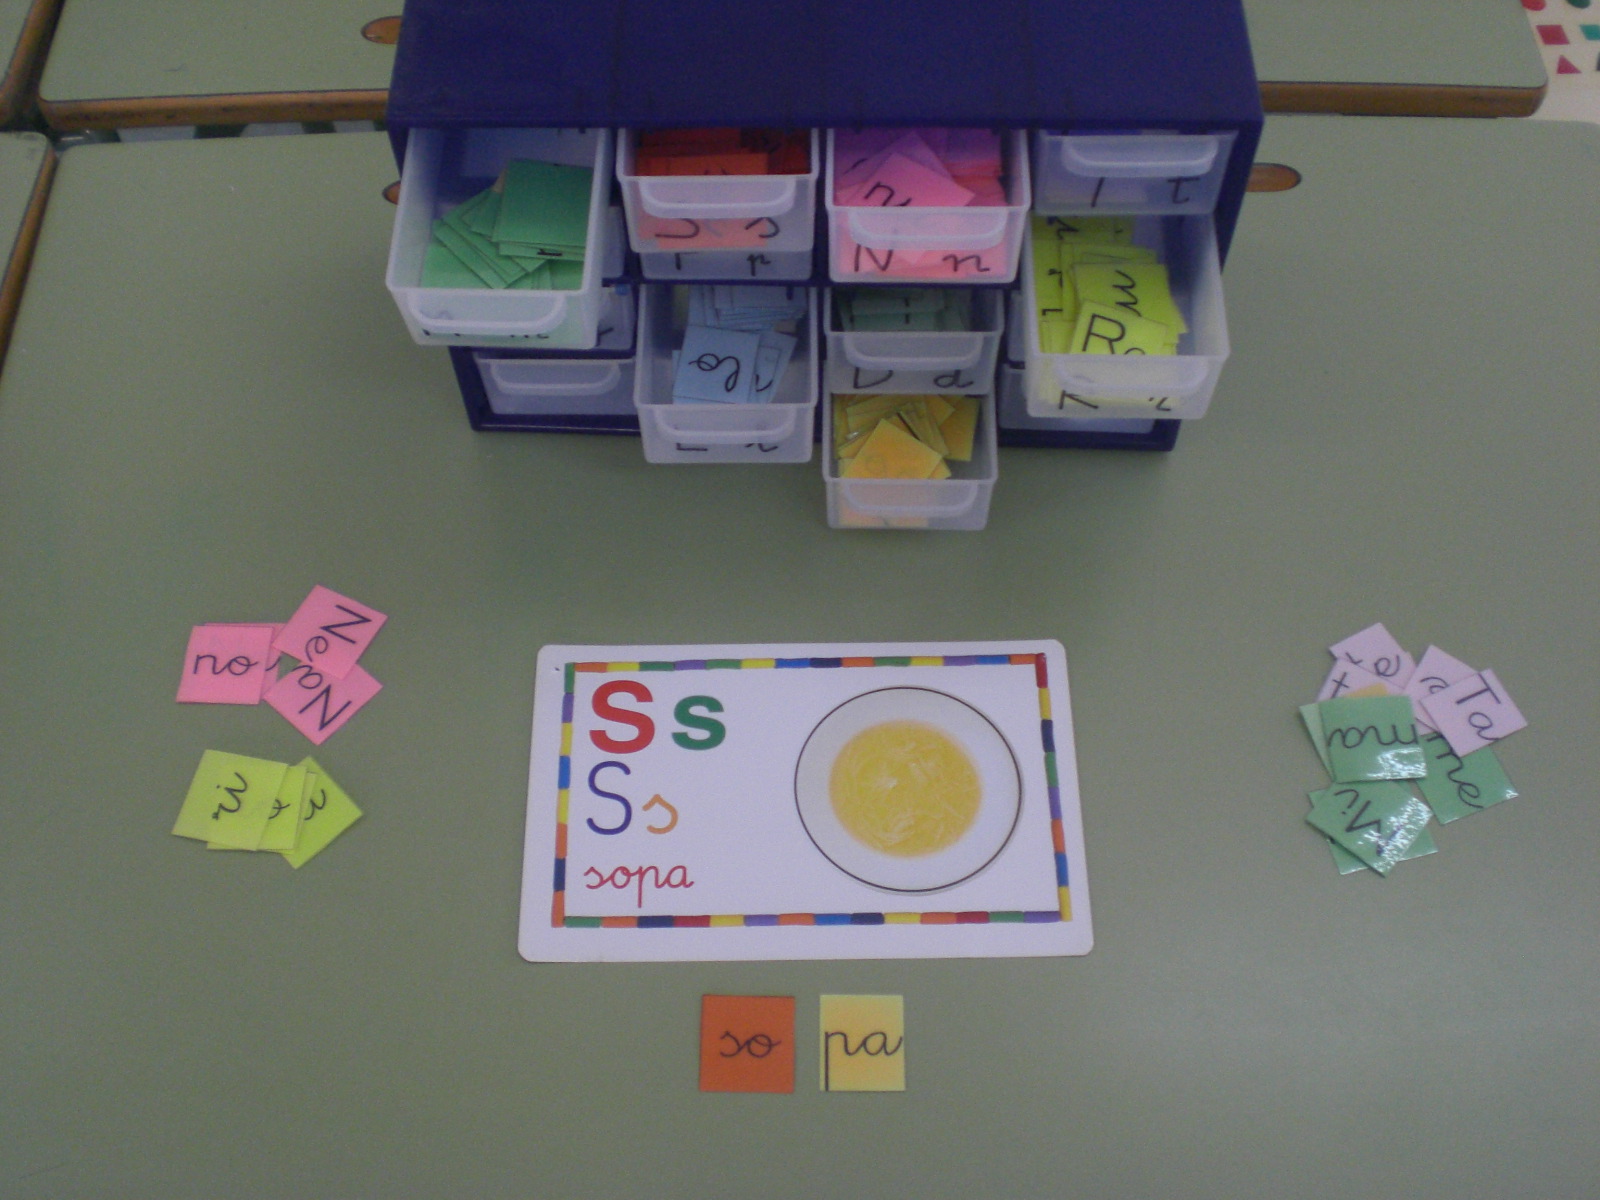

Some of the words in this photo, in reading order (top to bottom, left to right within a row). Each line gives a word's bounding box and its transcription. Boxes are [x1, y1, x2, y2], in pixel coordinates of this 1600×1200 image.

[305, 604, 372, 663] Ne
[193, 654, 259, 676] no
[589, 680, 656, 754] S
[671, 695, 727, 751] s
[1456, 673, 1501, 741] Ta
[586, 760, 633, 836] S
[642, 794, 679, 835] s
[584, 865, 695, 909] sopa
[720, 1031, 782, 1058] so
[824, 1031, 904, 1091] pa
